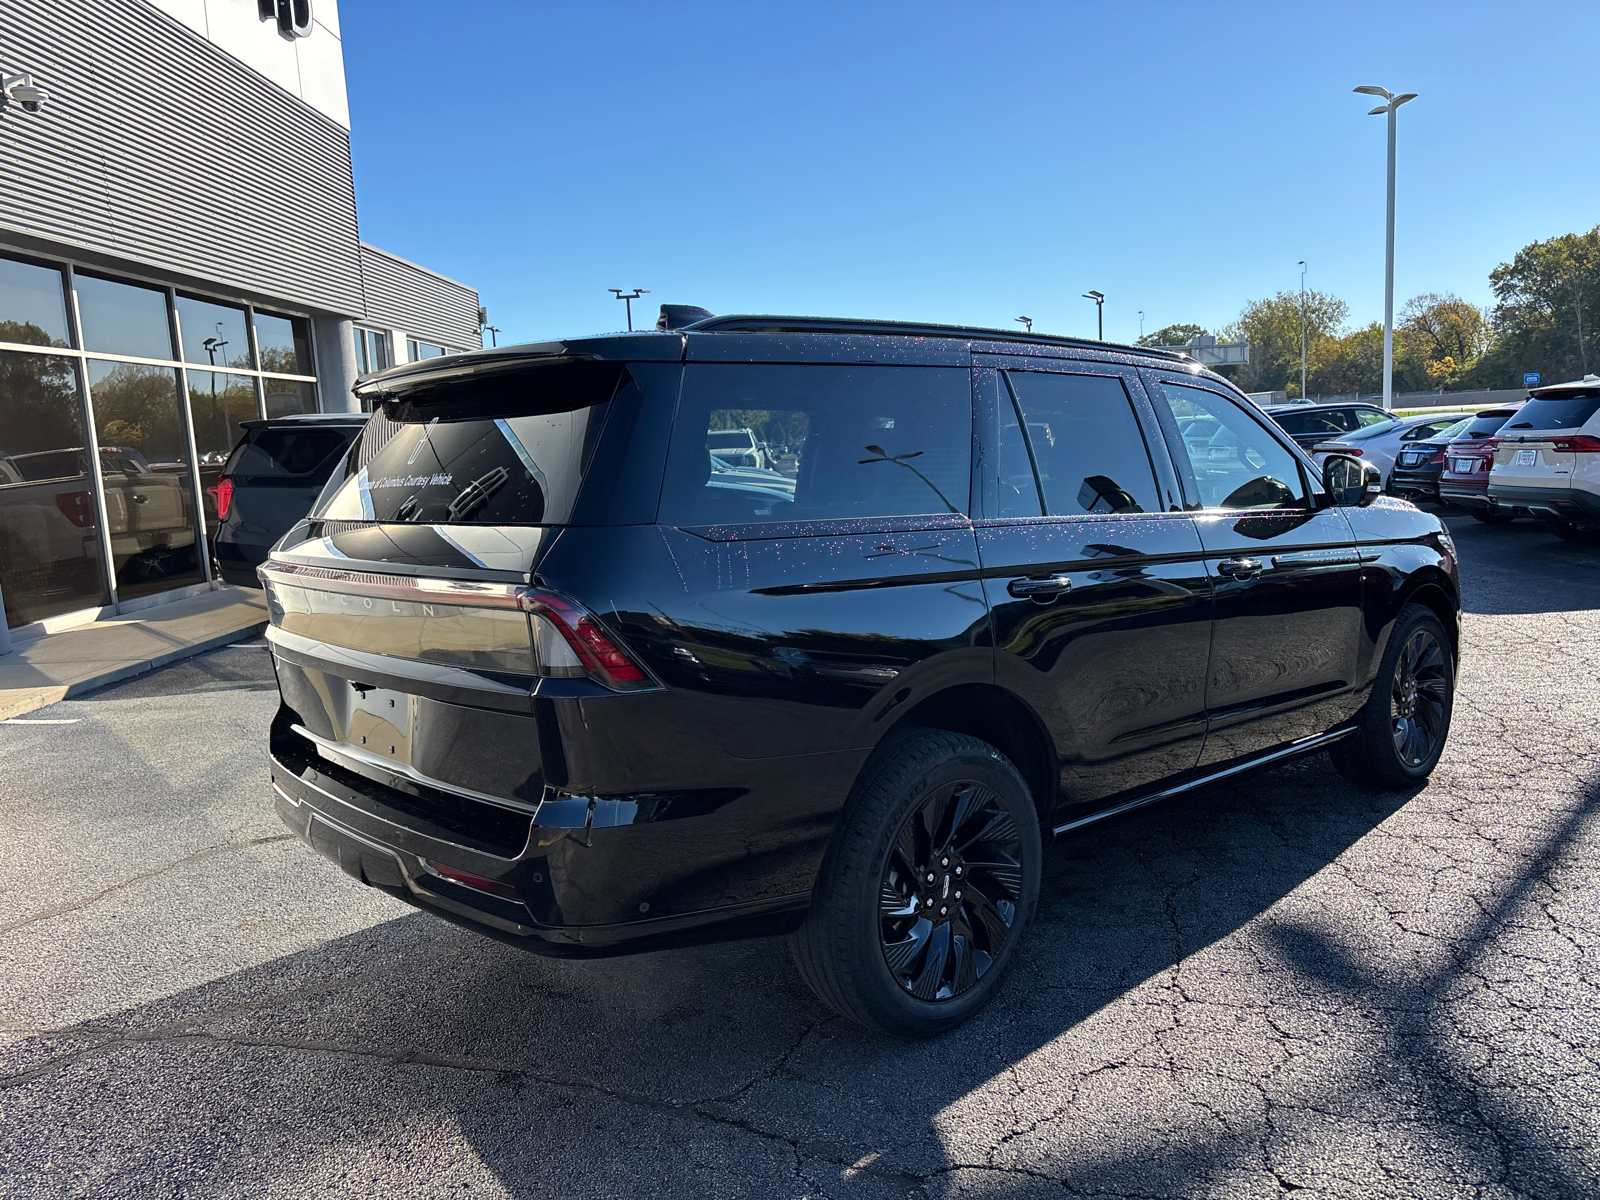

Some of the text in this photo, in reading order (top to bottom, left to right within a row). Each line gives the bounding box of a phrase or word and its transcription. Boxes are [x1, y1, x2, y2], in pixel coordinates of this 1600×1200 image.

[380, 476, 405, 488] Columbus
[404, 474, 430, 489] Courtesy
[430, 472, 452, 486] Vehicle
[294, 588, 434, 617] NCOLN
